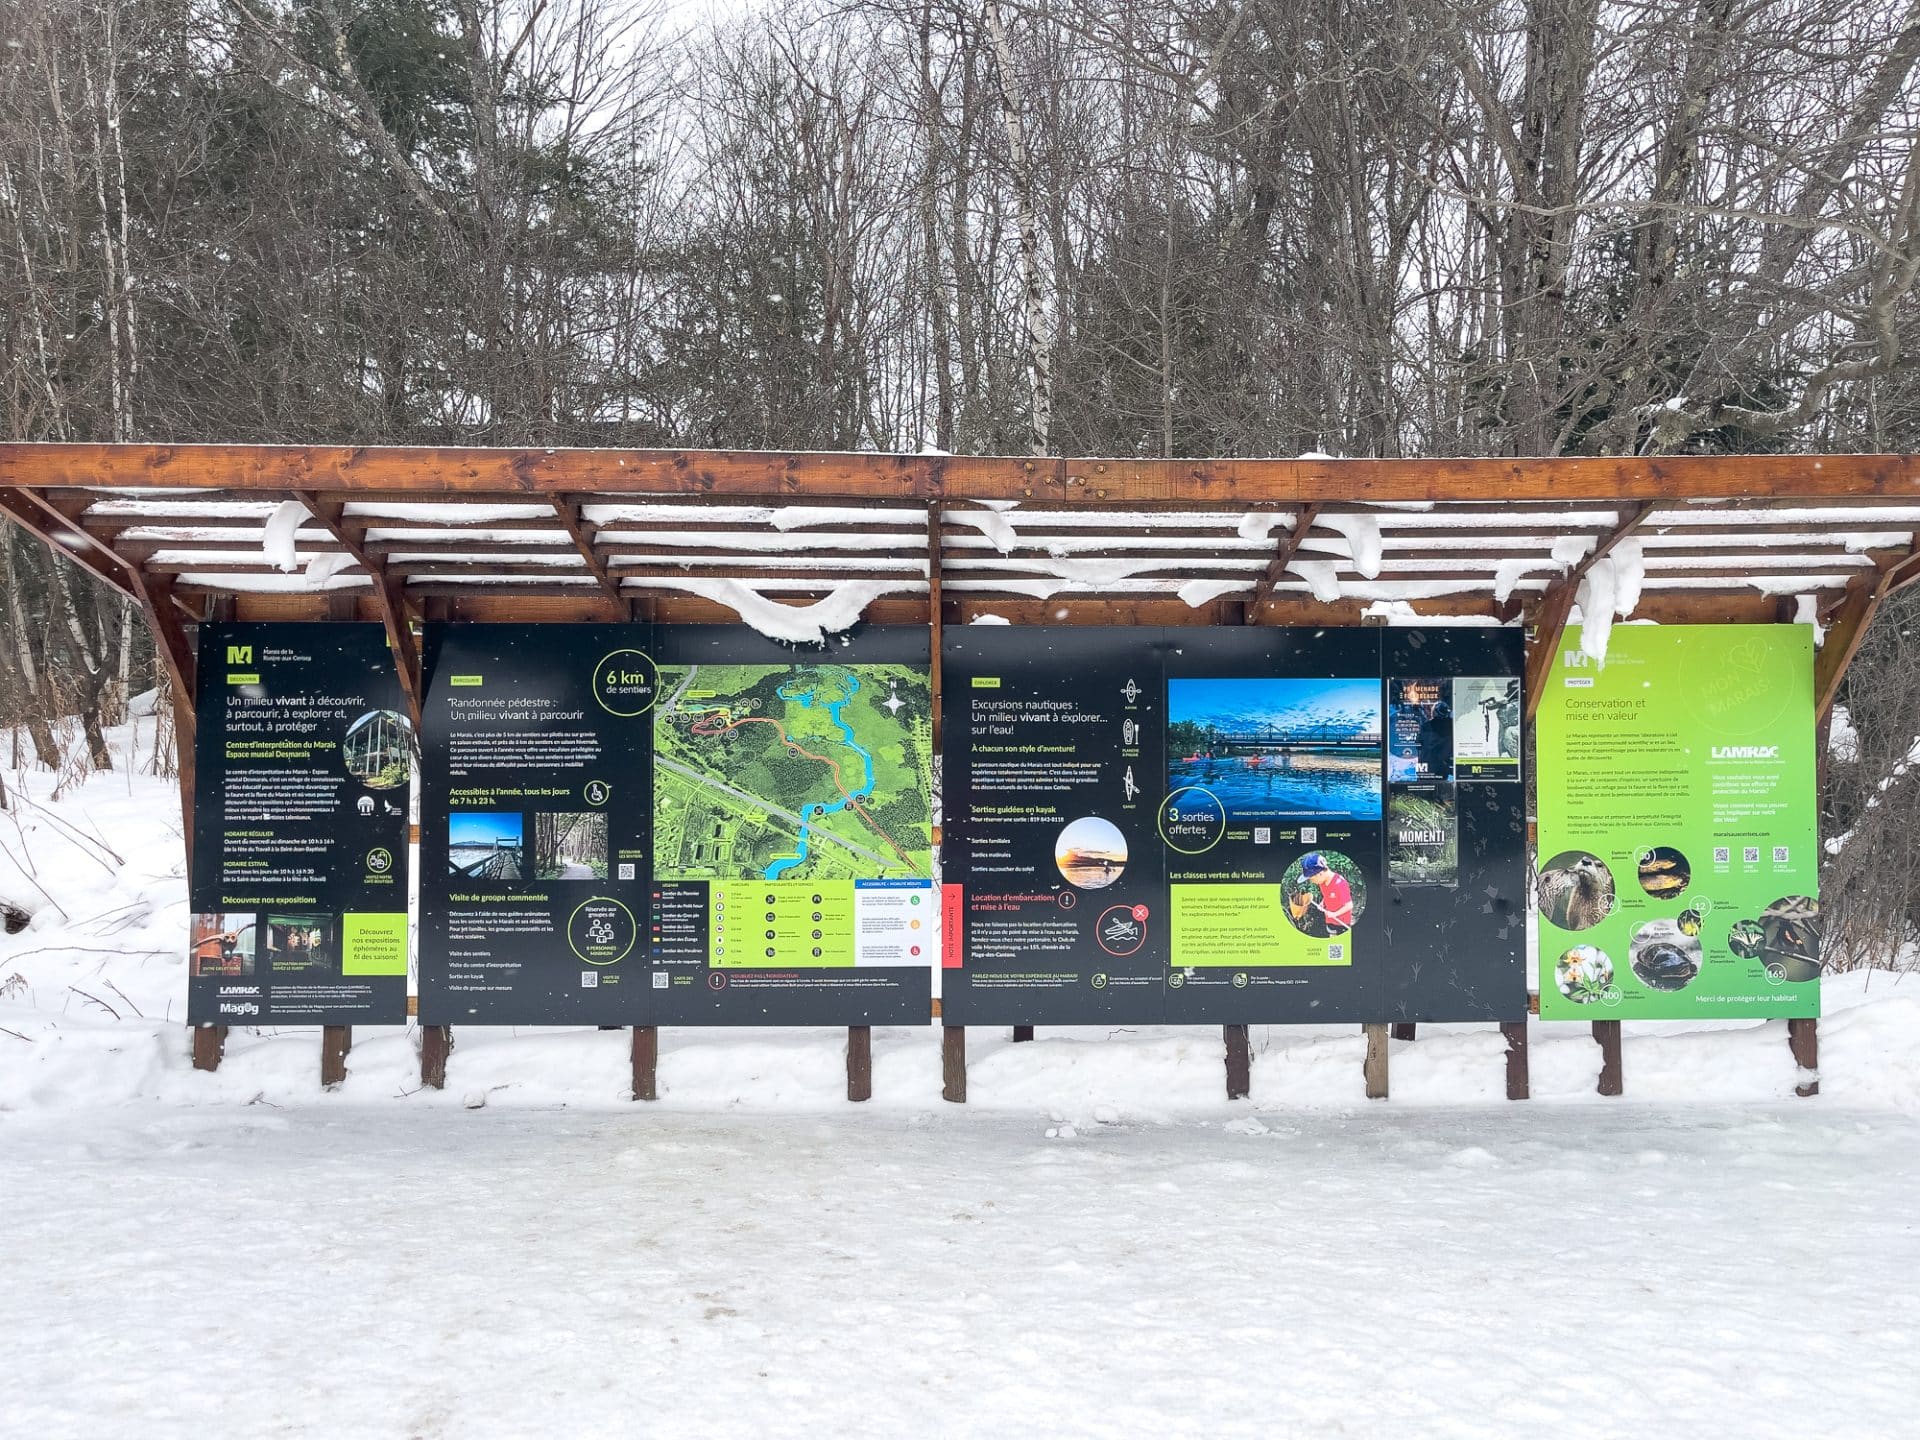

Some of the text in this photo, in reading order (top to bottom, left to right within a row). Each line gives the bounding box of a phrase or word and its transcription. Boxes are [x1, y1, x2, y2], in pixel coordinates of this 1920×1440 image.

[607, 671, 644, 684] 6 km
[606, 685, 651, 693] de sentiers
[226, 696, 366, 707] Un milieu vivant à découvrir,
[450, 698, 506, 707] Randonnée
[508, 698, 551, 708] pédestre
[972, 701, 1023, 709] Excursions
[1025, 701, 1073, 711] nautiques
[1565, 699, 1645, 708] Conservation et
[226, 709, 347, 720] à parcourir, à explorer et,
[451, 711, 584, 721] Un milieu vivant à parcourir
[972, 713, 1108, 723] Un milieu vivant à explorer...
[1566, 711, 1590, 720] mise
[1607, 711, 1638, 720] valeur
[226, 722, 317, 732] surtout, à protéger
[989, 725, 1014, 734] l'eau!
[971, 744, 978, 752] À
[1711, 745, 1779, 759] LAMRAC
[226, 751, 249, 759] Espace
[496, 788, 523, 796] l'année,
[552, 788, 570, 796] jours
[997, 806, 1024, 814] guidées
[1035, 806, 1056, 814] kayak
[1169, 808, 1215, 821] 3 sorties
[1169, 825, 1207, 834] offertes
[1399, 830, 1445, 843] MOMENTI
[1695, 902, 1706, 910] 12
[353, 945, 388, 953] éphémères
[1767, 970, 1784, 979] 165
[1602, 991, 1619, 1000] 400
[1727, 995, 1756, 1003] protéger
[220, 1002, 259, 1015] Magog
